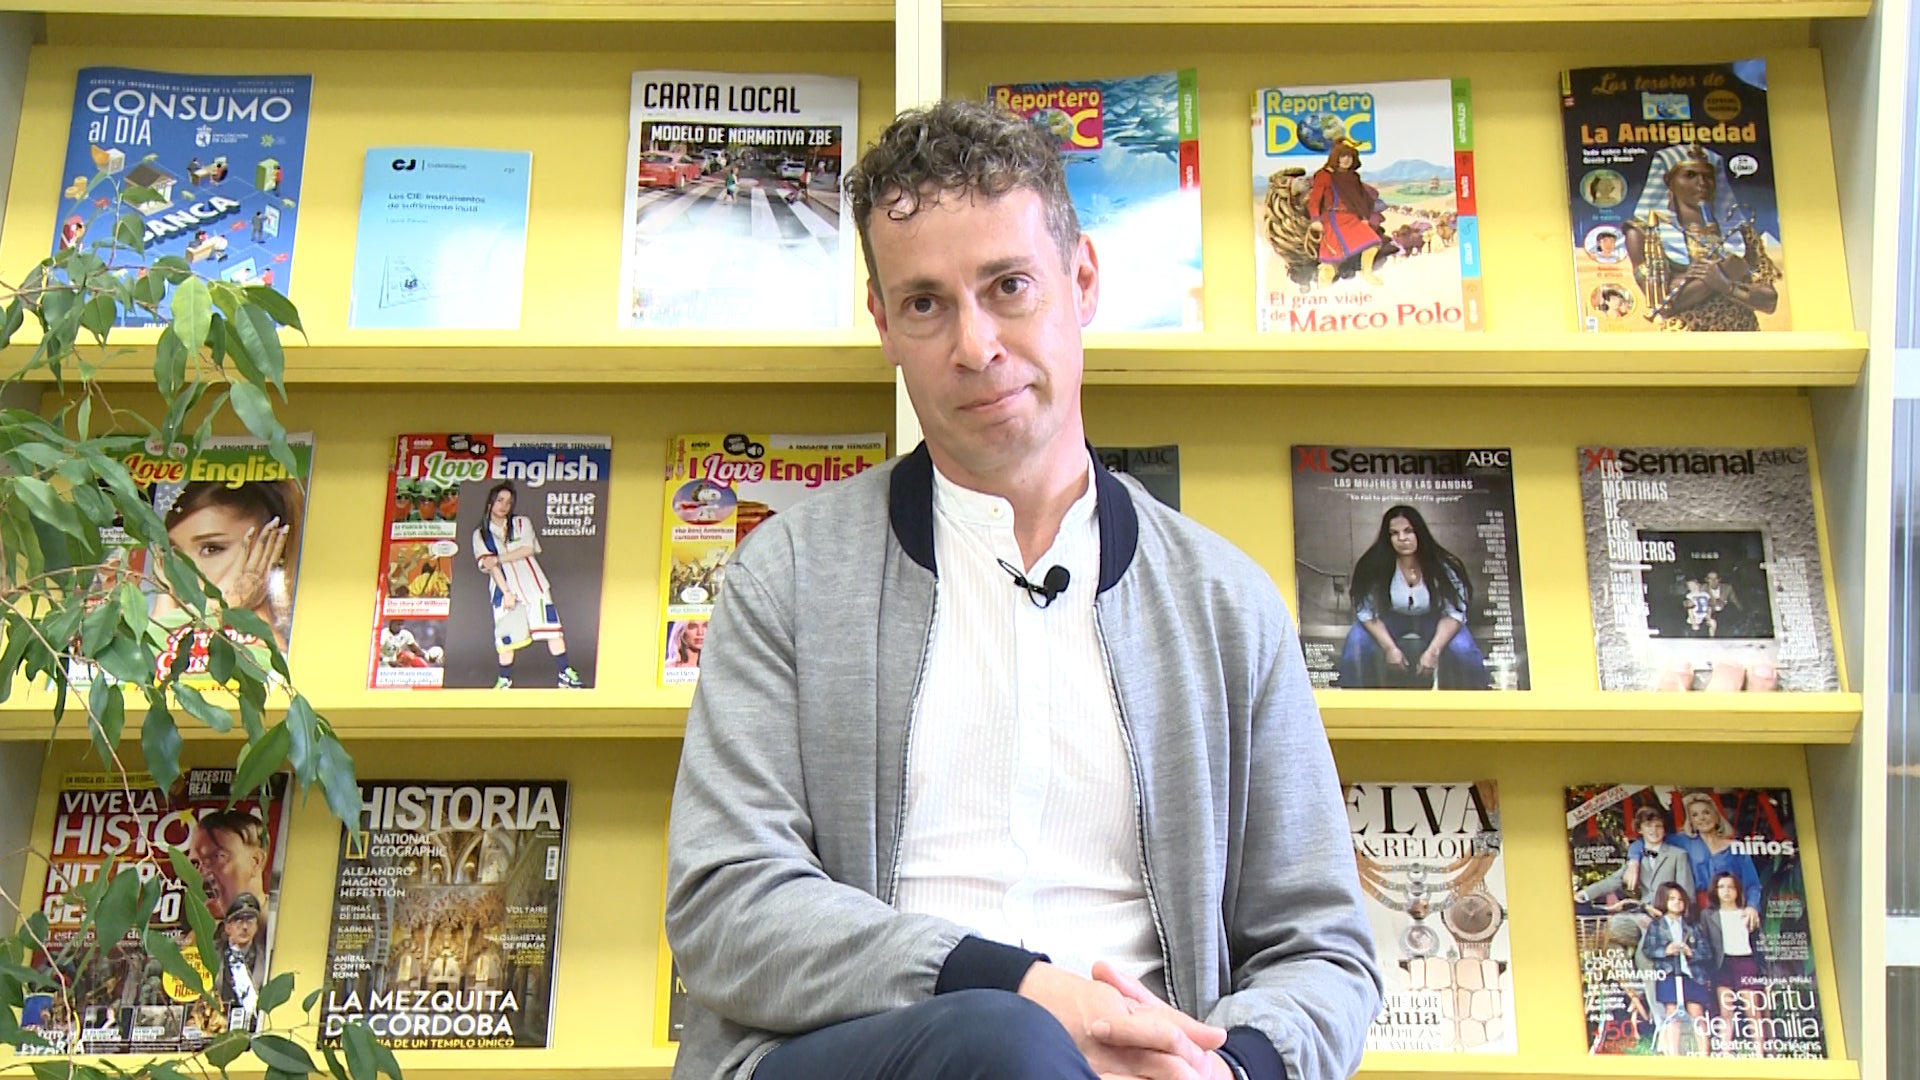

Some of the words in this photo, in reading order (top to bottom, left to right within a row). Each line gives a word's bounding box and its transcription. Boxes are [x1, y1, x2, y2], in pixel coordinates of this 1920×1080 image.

[87, 87, 292, 122] CONSUMO
[644, 82, 719, 111] CARTA
[728, 85, 800, 114] LOCAL
[995, 88, 1100, 112] Reportero
[1266, 91, 1372, 115] Reportero
[88, 115, 108, 143] al
[651, 125, 704, 143] MODELO
[708, 127, 725, 144] DE
[728, 127, 805, 146] NORMATIVA
[808, 129, 832, 146] ZBE
[1581, 123, 1609, 145] La
[1618, 121, 1757, 144] Antigüedad
[392, 159, 416, 171] CJ
[143, 195, 240, 246] ANCA
[1270, 292, 1285, 306] El
[1292, 294, 1328, 308] gran
[1335, 292, 1373, 306] viaje
[1270, 309, 1287, 321] de
[1289, 308, 1388, 333] Marco
[1396, 302, 1462, 328] Polo
[1465, 450, 1510, 467] ABC
[123, 452, 184, 489] Love
[424, 451, 488, 488] Love
[492, 453, 598, 488] English
[690, 457, 698, 479] I
[702, 453, 765, 490] Love
[769, 454, 874, 488] English
[1600, 459, 1624, 480] LAS
[1333, 478, 1351, 489] LAS
[1354, 478, 1398, 490] MUJERES
[1400, 479, 1412, 490] EN
[1415, 479, 1432, 490] LAS
[1434, 479, 1474, 491] BANDAS
[1602, 480, 1668, 502] MENTIRAS
[1604, 499, 1620, 519] DE
[541, 525, 596, 537] successful
[547, 516, 581, 528] Young
[1606, 520, 1630, 540] LOS
[1608, 540, 1676, 563] CORDEROS
[190, 770, 232, 783] INCESTO
[189, 783, 212, 796] REAL
[63, 791, 123, 813] VIVE
[128, 791, 158, 813] LA
[357, 786, 561, 830] HISTORIA
[1347, 784, 1499, 836] ELVA
[373, 833, 431, 845] NATIONAL
[1731, 834, 1795, 856] niños
[371, 845, 447, 857] GEOGRAPHIC
[341, 877, 388, 887] MAGNO
[390, 877, 398, 887] Y
[342, 867, 413, 876] ALEJANDRO
[506, 905, 548, 914] VOLTAIRE
[516, 942, 546, 950] PRAGA
[1584, 948, 1625, 961] ELLOS
[333, 962, 371, 971] CONTRA
[1585, 959, 1633, 970] COPIAN
[1587, 970, 1603, 981] TU
[1606, 969, 1667, 982] ARMARIO
[328, 990, 363, 1012] LA
[369, 990, 519, 1013] MEZQUITA
[1720, 984, 1816, 1016] espíritu
[368, 1011, 514, 1037] CÓRDOBA
[1693, 1009, 1727, 1038] de
[1733, 1011, 1820, 1038] familia
[394, 1038, 405, 1048] DE
[412, 1038, 428, 1048] UN
[435, 1038, 476, 1048] TEMPLO
[478, 1036, 515, 1048] ÚNICO
